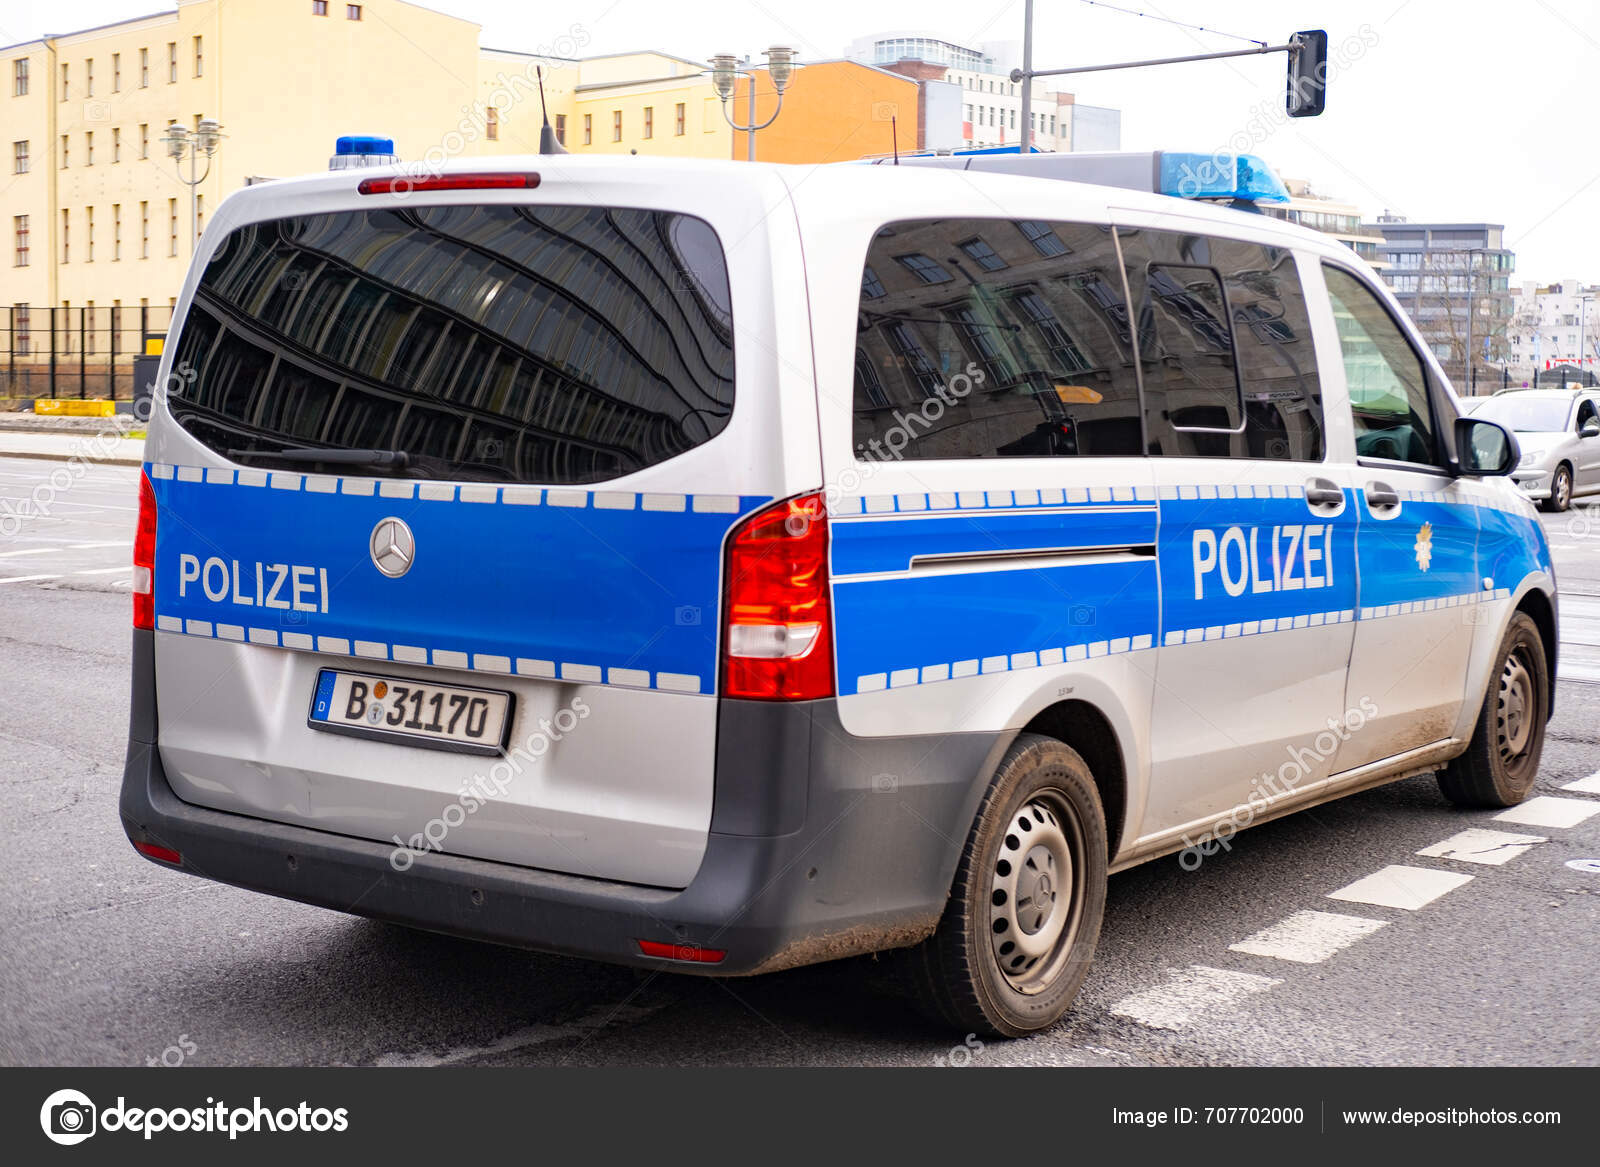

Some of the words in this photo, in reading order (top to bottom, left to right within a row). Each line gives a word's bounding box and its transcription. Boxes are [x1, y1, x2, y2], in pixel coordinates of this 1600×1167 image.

[179, 553, 329, 614] POLIZEI
[1192, 524, 1334, 600] POLIZEI
[318, 701, 325, 712] D
[345, 680, 369, 720] B
[386, 686, 489, 738] 31170
